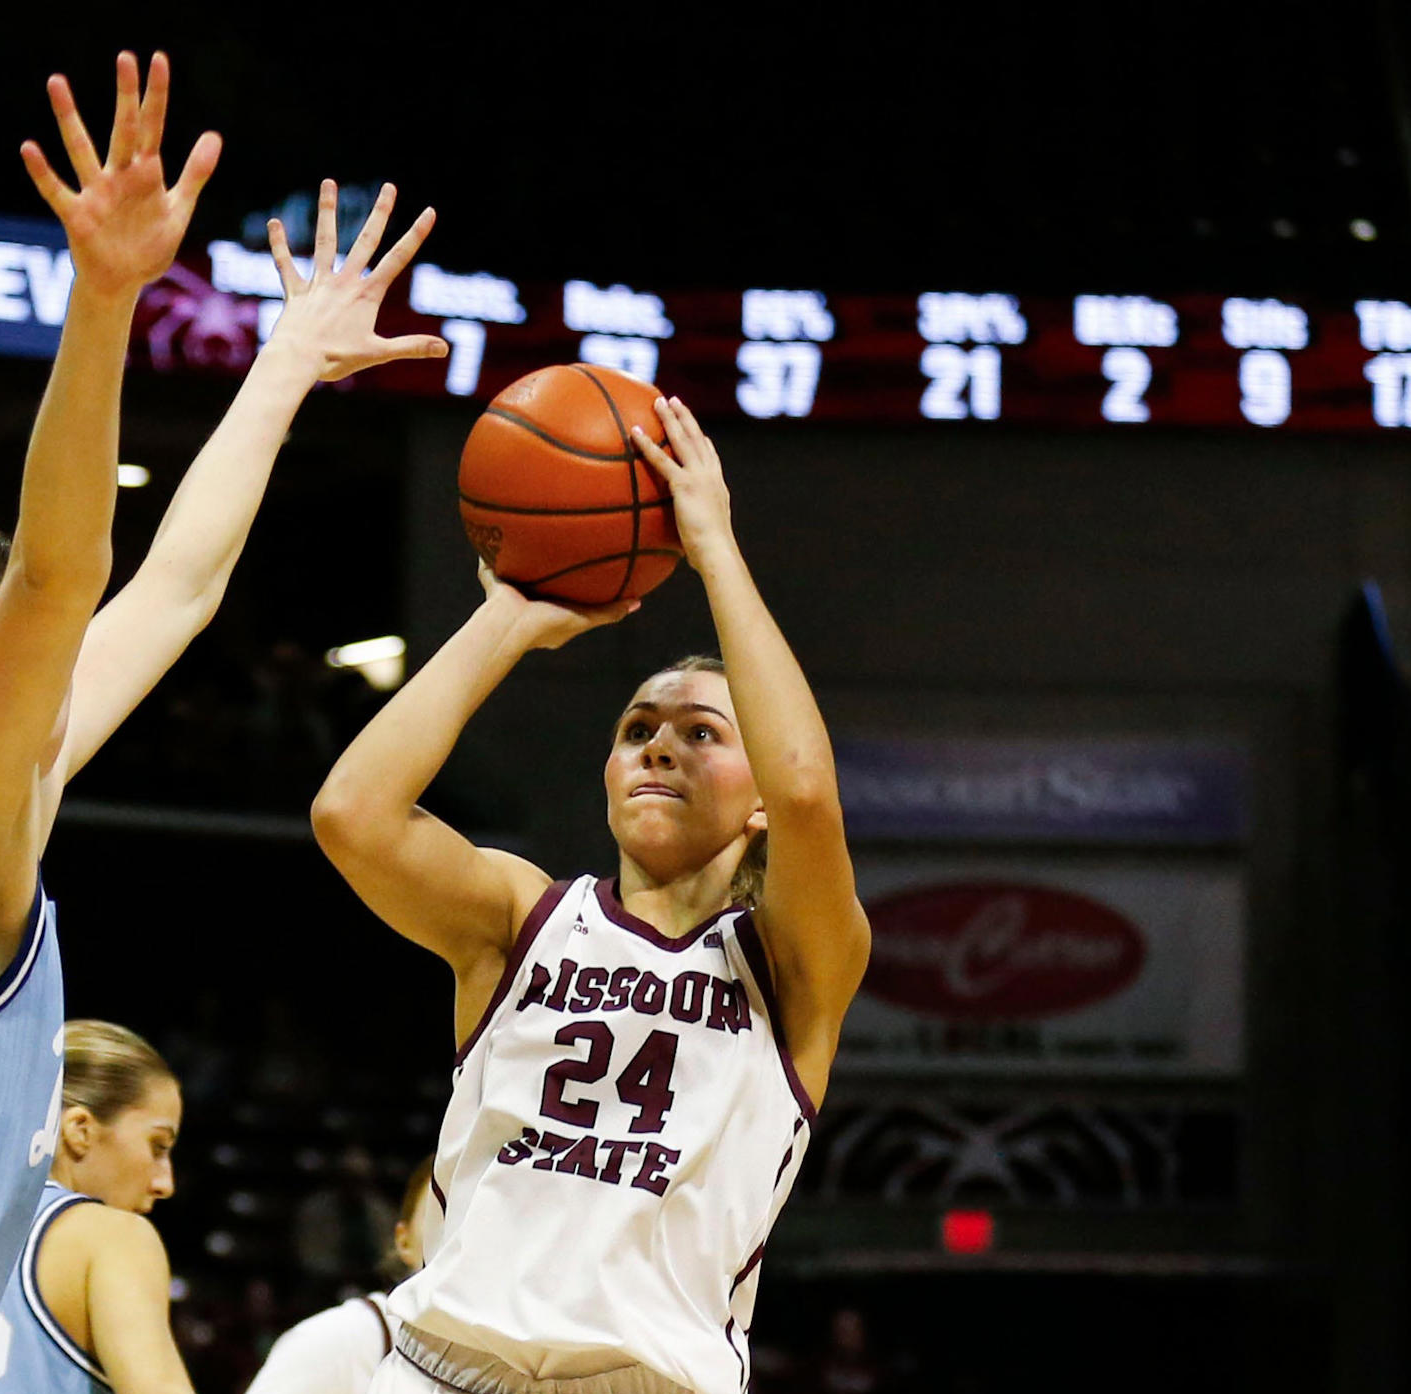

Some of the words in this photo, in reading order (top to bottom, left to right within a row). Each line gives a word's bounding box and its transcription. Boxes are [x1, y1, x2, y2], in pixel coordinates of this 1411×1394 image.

[440, 318, 487, 396] 7
[736, 341, 822, 417] 37
[920, 343, 1001, 420] 21
[1101, 346, 1152, 422] 2
[1238, 350, 1292, 426] 9
[539, 1021, 679, 1134] 24
[497, 1127, 682, 1197] STATE
